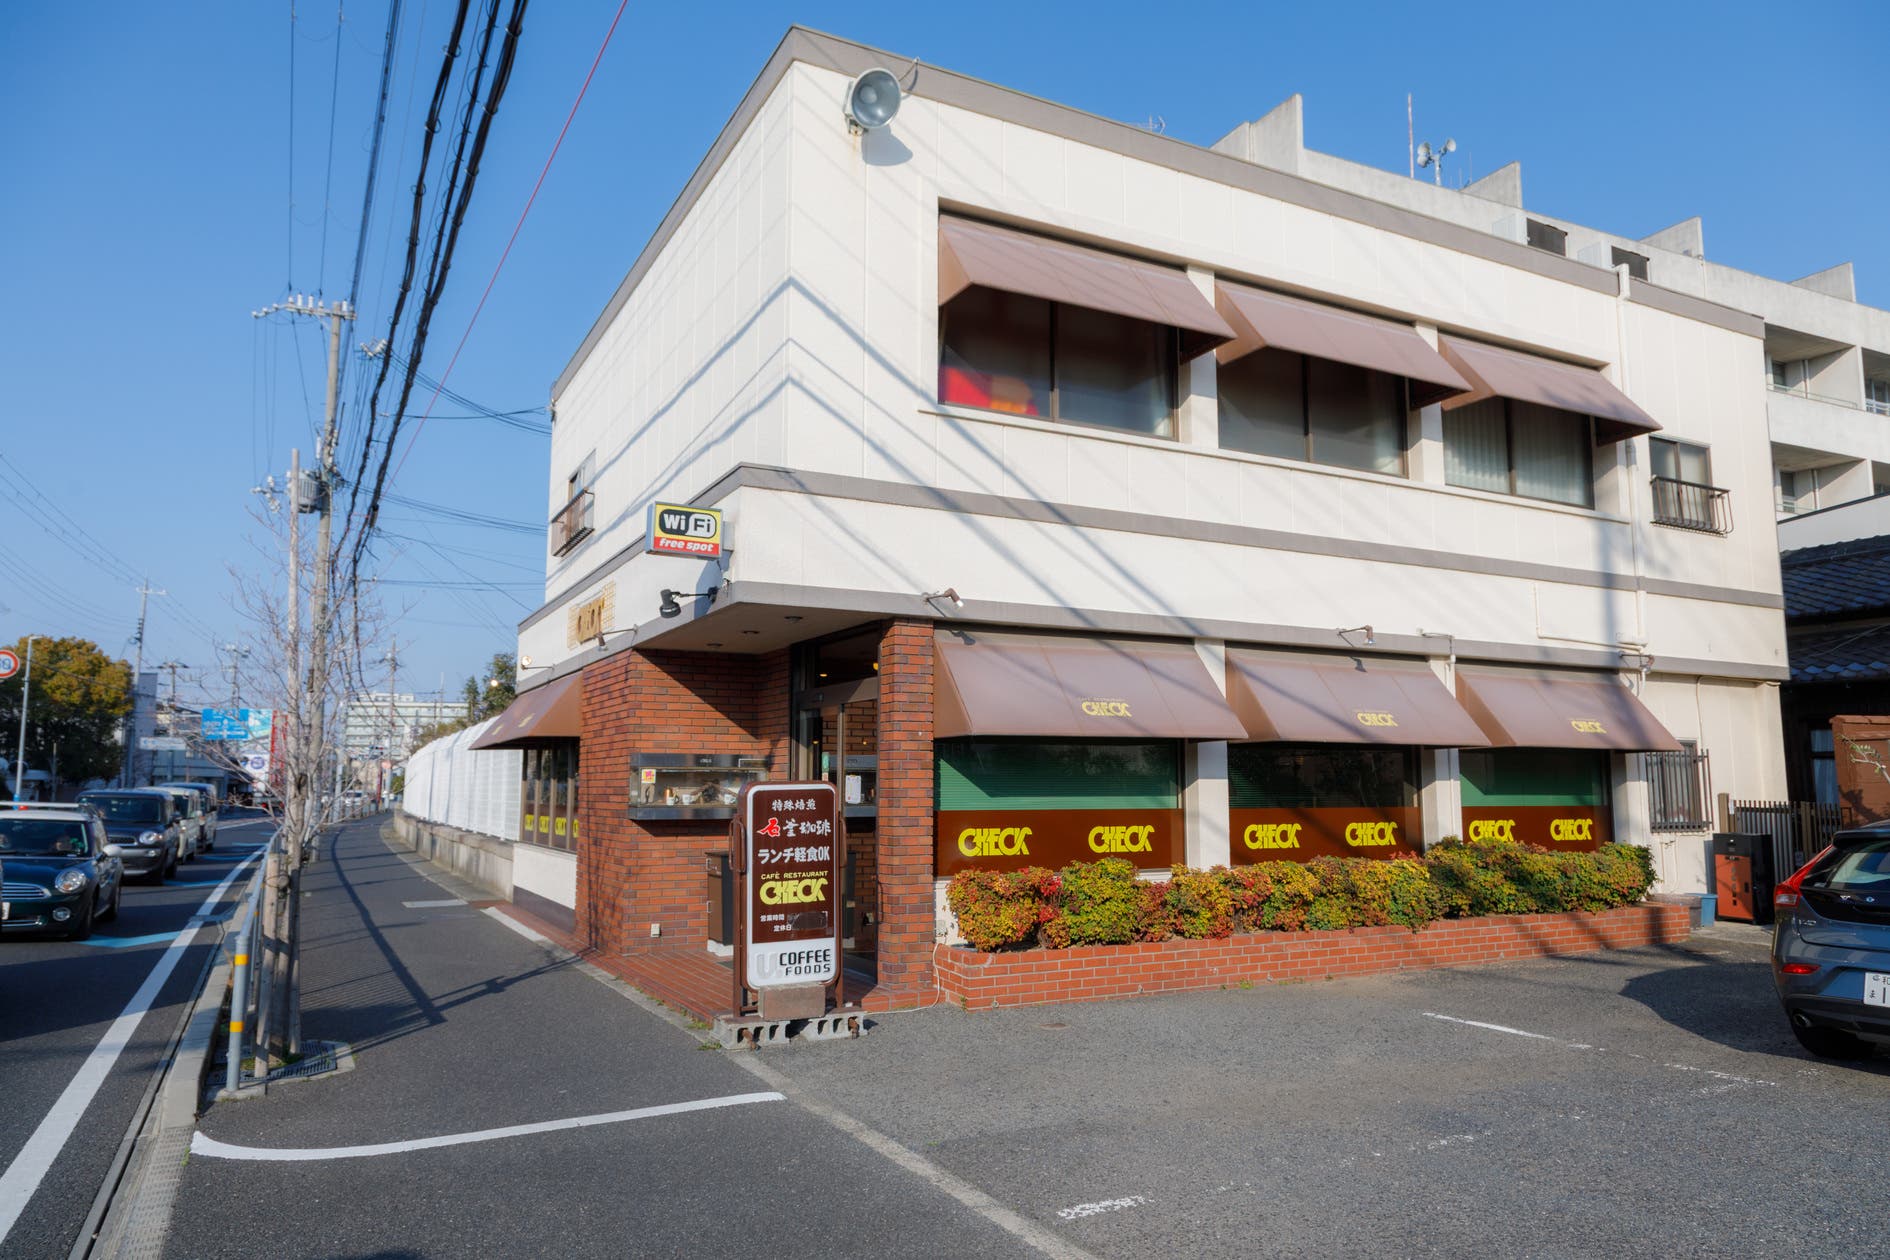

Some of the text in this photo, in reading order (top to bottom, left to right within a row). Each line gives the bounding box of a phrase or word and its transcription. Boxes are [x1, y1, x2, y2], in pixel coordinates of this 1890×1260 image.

[686, 541, 714, 552] spot
[1082, 701, 1132, 717] CHECK
[1357, 712, 1398, 727] CHECK
[1088, 825, 1155, 853] CHECK
[1244, 823, 1302, 850] CHECK
[1345, 822, 1398, 848] CHECK
[1468, 819, 1517, 843] CHECK
[1549, 818, 1594, 842] CHECK
[957, 826, 1033, 857] CHECK
[757, 845, 830, 865] ランチ軽食OK
[783, 870, 829, 879] RESTAURANT
[759, 878, 828, 905] CHECK
[779, 948, 831, 967] COFFEE
[785, 963, 831, 976] FOODS
